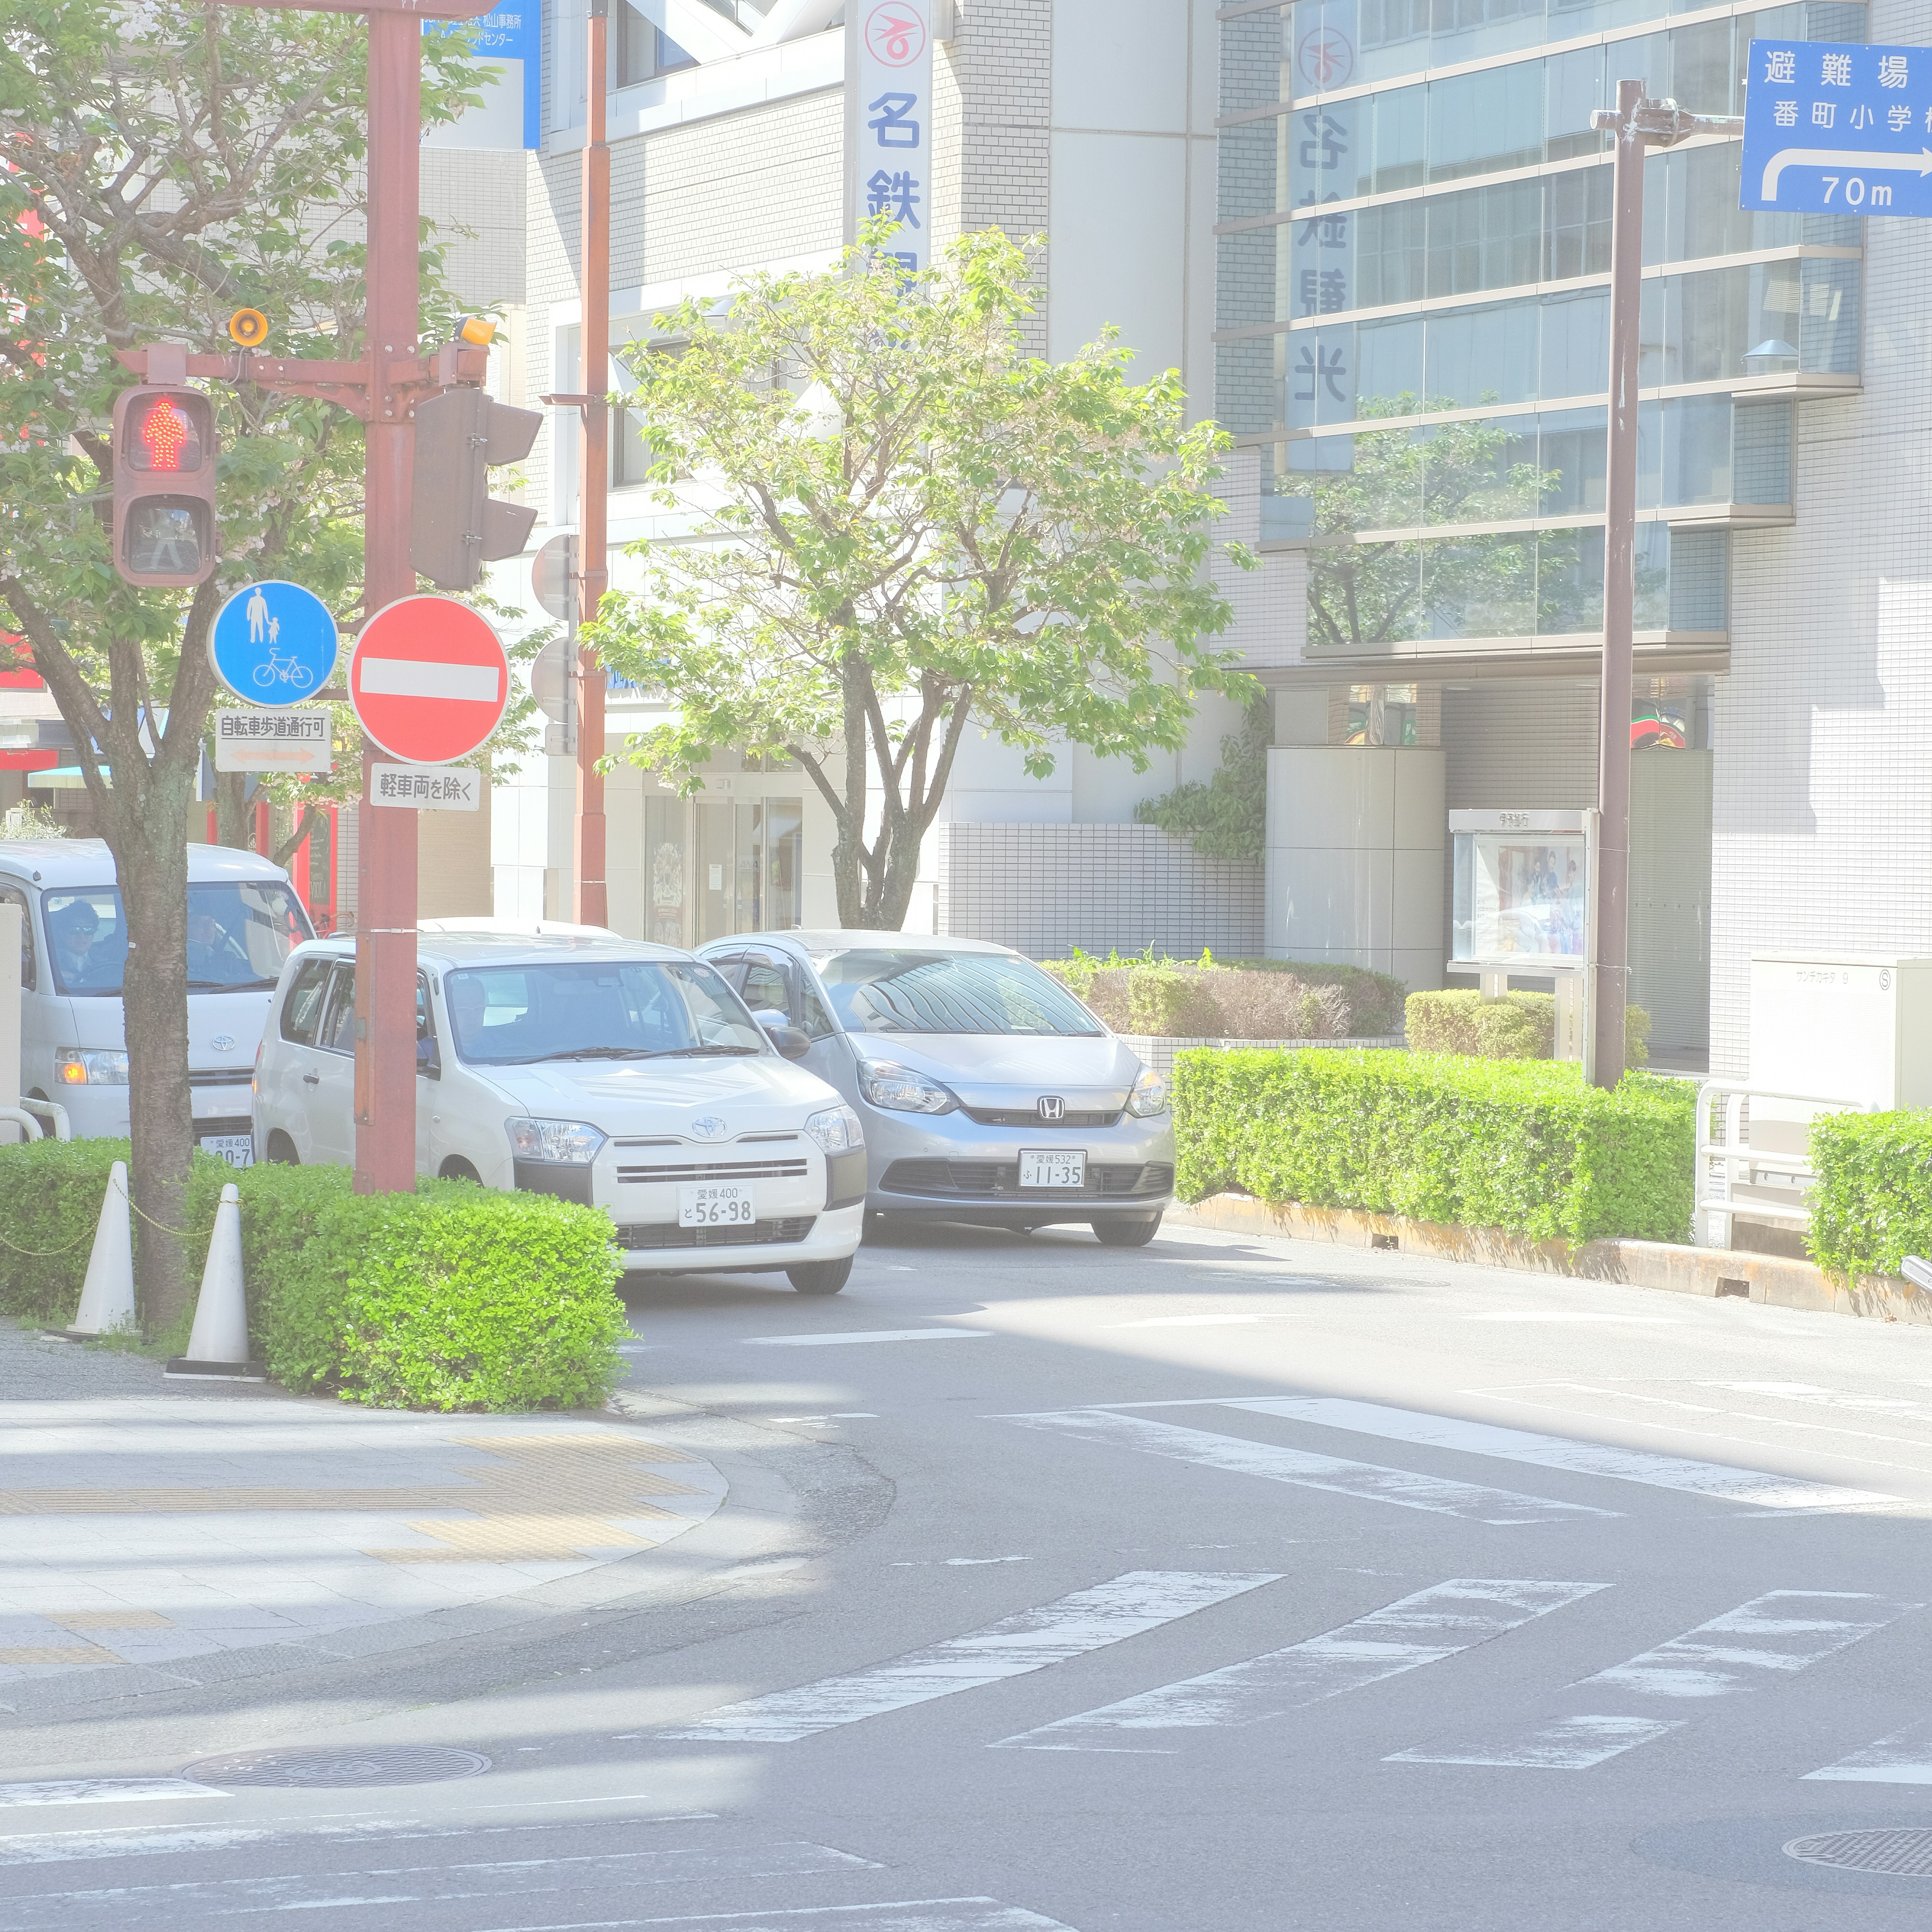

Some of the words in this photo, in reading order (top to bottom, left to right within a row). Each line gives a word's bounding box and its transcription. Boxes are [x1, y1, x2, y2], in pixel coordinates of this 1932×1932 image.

[483, 13, 522, 29] 松山事務所
[1764, 51, 1908, 89] 避難場
[1822, 177, 1892, 206] 70m
[221, 715, 326, 737] 自転車歩道通行可
[380, 773, 471, 801] 軽車両を除く
[1843, 972, 1848, 984] 9
[1023, 1170, 1032, 1179] ふ
[1036, 1166, 1081, 1184] 11-35
[684, 1208, 692, 1219] と
[696, 1201, 751, 1223] 56-98
